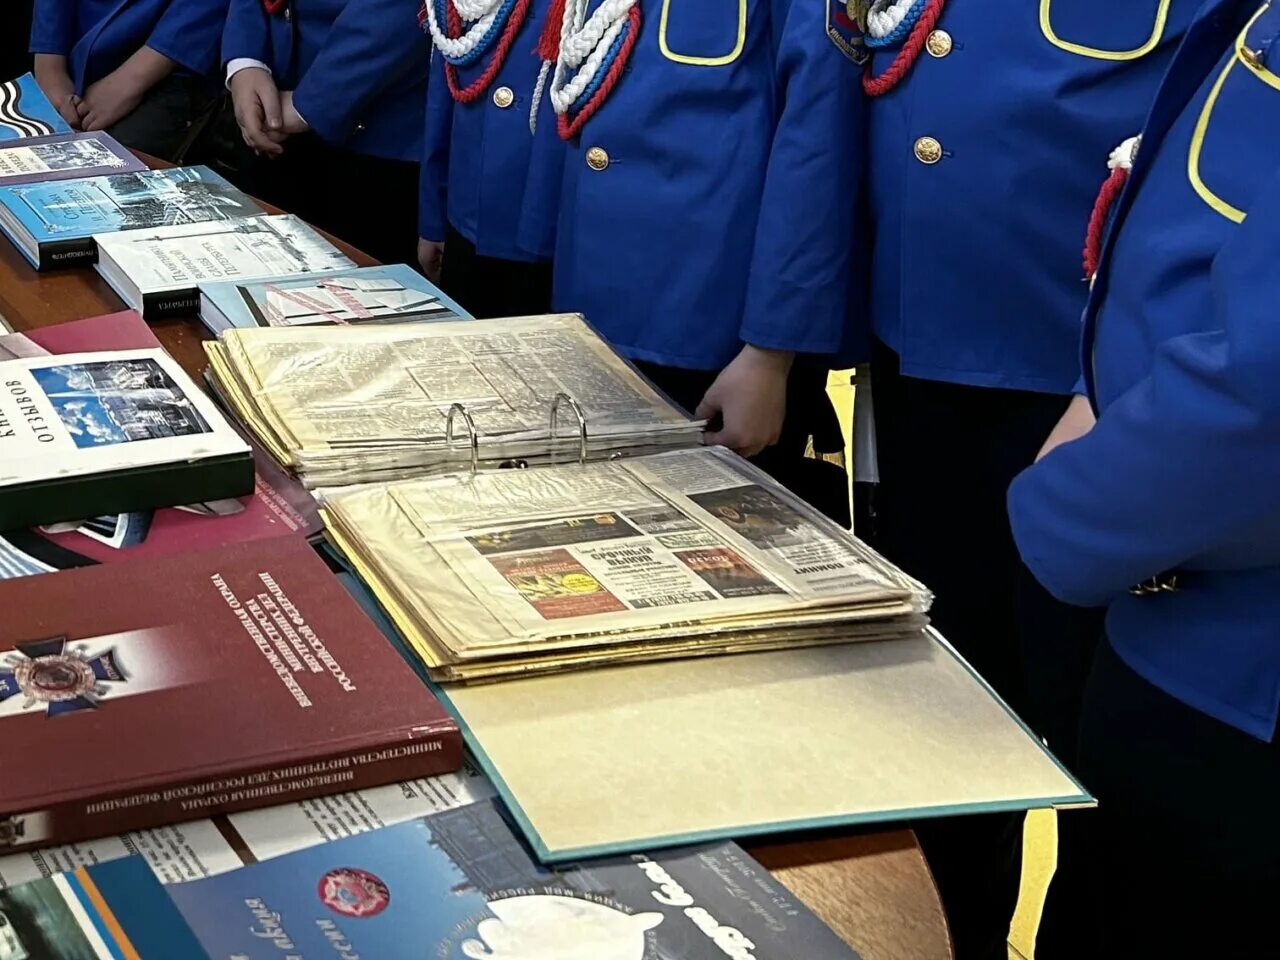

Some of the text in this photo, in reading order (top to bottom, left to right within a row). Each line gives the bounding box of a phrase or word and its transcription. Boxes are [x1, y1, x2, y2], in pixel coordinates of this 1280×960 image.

[5, 379, 55, 444] ОТЗЫВОВ
[210, 573, 240, 609] ОХРАНА
[86, 740, 443, 814] МИНИСТЕРСТВА ВНУТРЕННИХ ДЕЛ РОССИЙСКОЙ ФЕДЕРАЦИИ
[180, 771, 355, 811] ВНЕВЕДОМСТВЕННАЯ ОХРАНА
